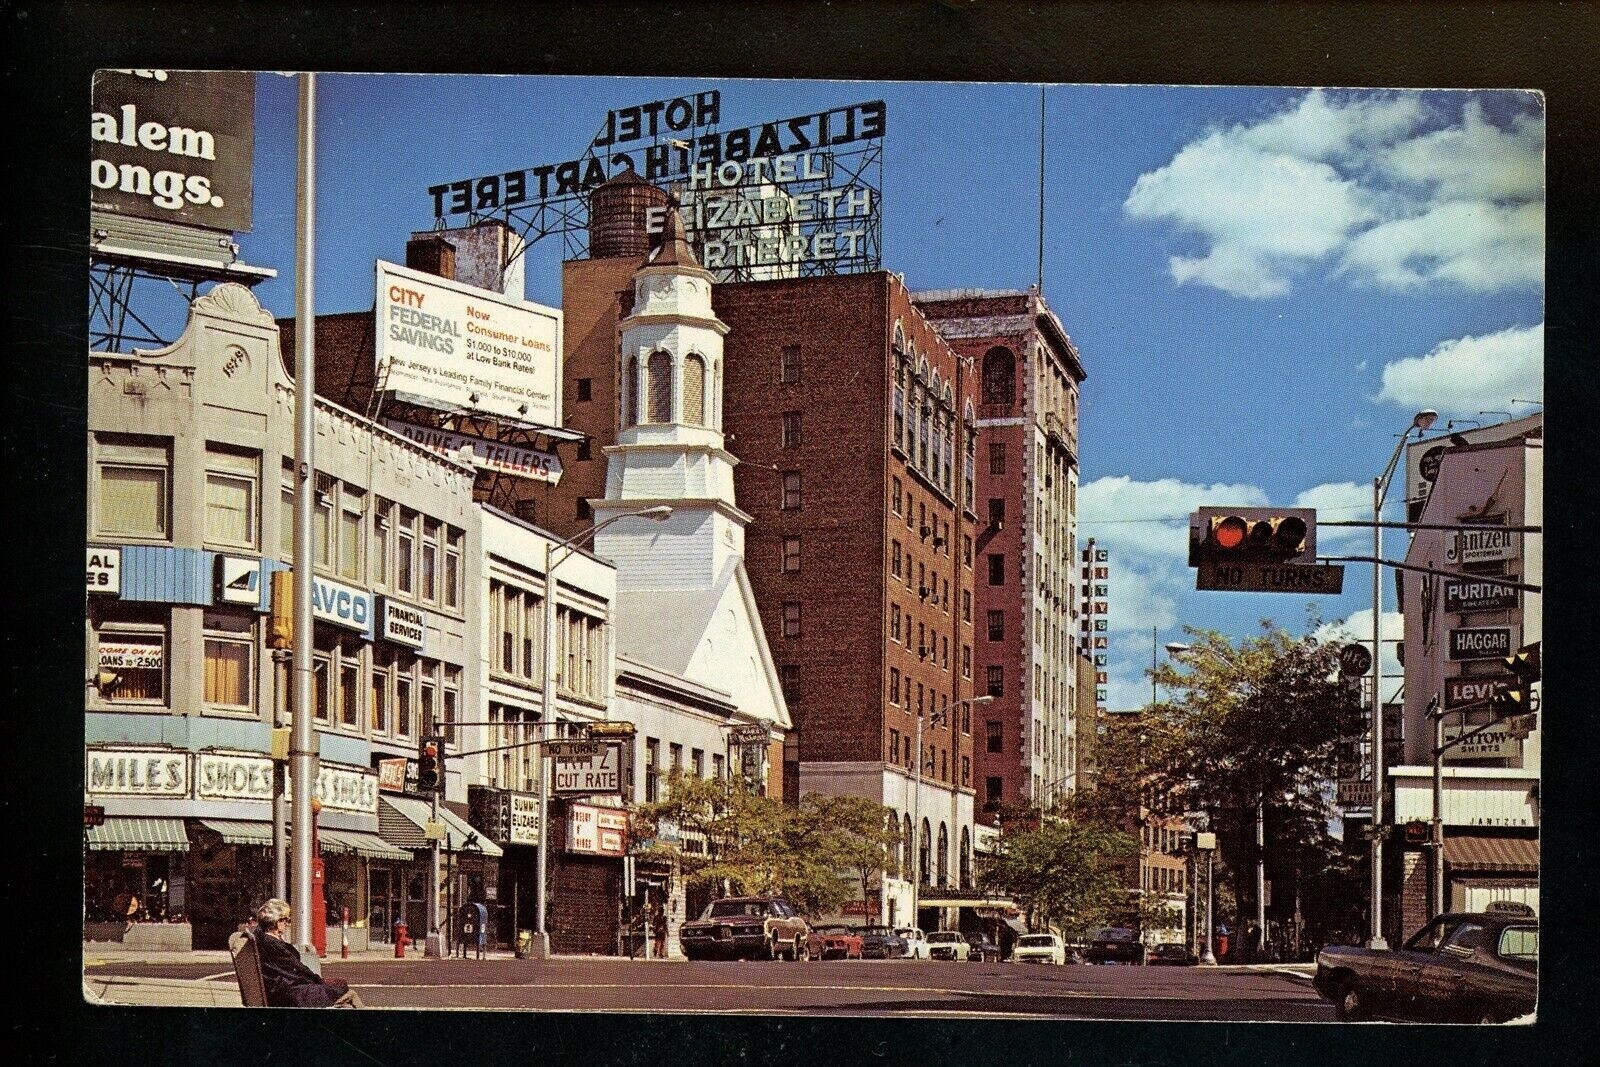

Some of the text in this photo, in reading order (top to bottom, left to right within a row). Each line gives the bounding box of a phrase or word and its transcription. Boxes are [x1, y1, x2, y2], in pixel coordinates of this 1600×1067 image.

[91, 104, 217, 160] alem
[691, 153, 827, 191] HOTEL
[91, 159, 225, 209] ongs.
[646, 189, 874, 234] EIZABETH
[690, 229, 867, 270] RTERET
[389, 286, 425, 309] CITY
[390, 305, 463, 337] FEDERAL
[389, 324, 455, 356] SAVINGS
[467, 321, 551, 353] Consumer Loans
[466, 351, 476, 361] at
[477, 353, 491, 365] Low
[492, 356, 511, 369] Bank
[493, 345, 502, 355] to
[439, 366, 467, 384] Leading
[469, 375, 492, 390] Family
[485, 444, 551, 476] TELLERS
[88, 555, 115, 568] AL
[87, 572, 109, 585] ES
[1215, 566, 1325, 587] NO TURNS
[1448, 582, 1514, 601] PURITAN
[312, 582, 367, 624] AVCO
[388, 605, 424, 627] FINANCIAL
[389, 621, 422, 642] SERVICES
[1456, 633, 1507, 651] HAGGAR
[98, 647, 127, 655] COME
[98, 655, 124, 667] OANS
[548, 743, 599, 755] NO TURNS
[1461, 744, 1500, 753] SHIRTS
[91, 757, 182, 791] MILES
[202, 761, 273, 794] SHOES
[557, 772, 616, 788] CUT RATE
[514, 798, 540, 813] SUMMIT
[500, 795, 509, 840] BANK
